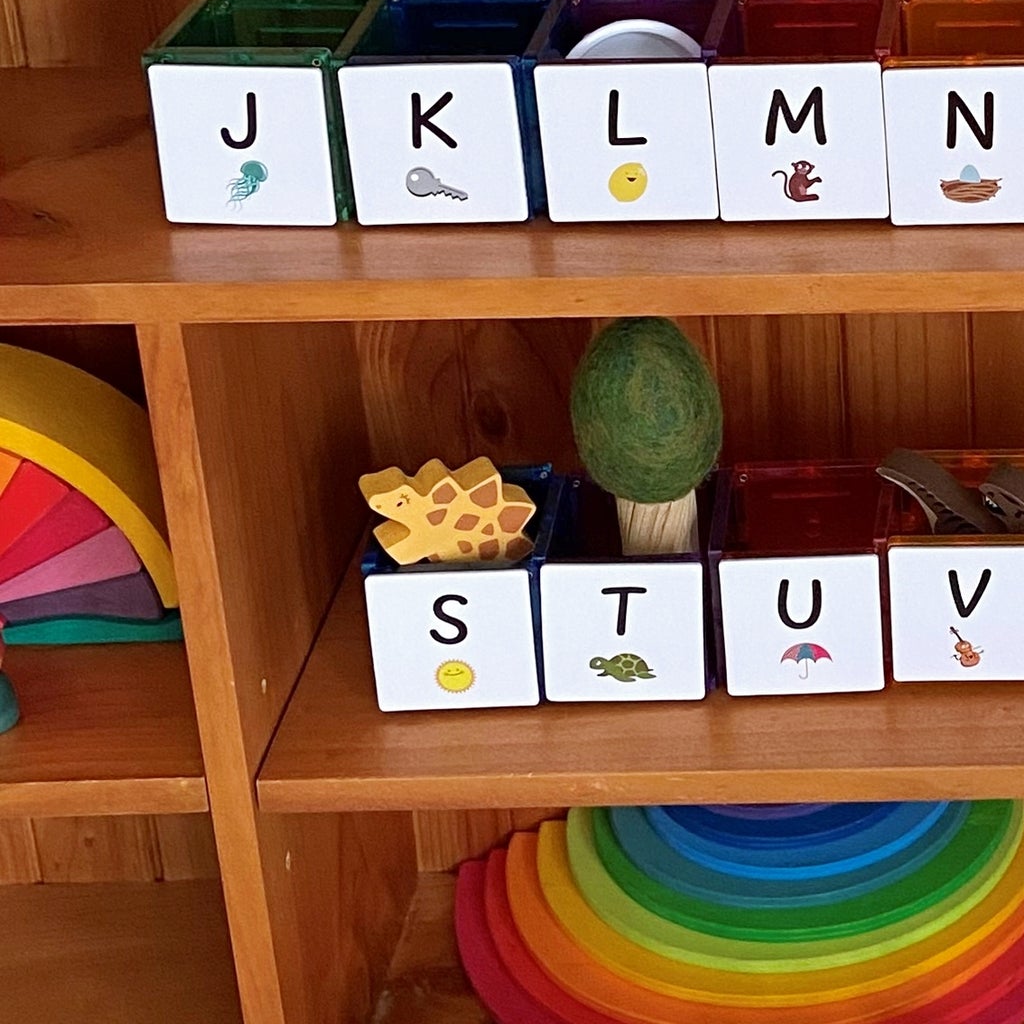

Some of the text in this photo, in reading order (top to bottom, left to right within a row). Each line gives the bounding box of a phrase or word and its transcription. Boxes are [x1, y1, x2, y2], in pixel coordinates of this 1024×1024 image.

[220, 91, 257, 150] J
[410, 91, 458, 149] K
[608, 89, 648, 146] L
[764, 86, 828, 146] M
[946, 90, 995, 151] N
[429, 594, 468, 645] S
[600, 586, 648, 636] T
[777, 578, 822, 630] U
[947, 568, 992, 619] V
